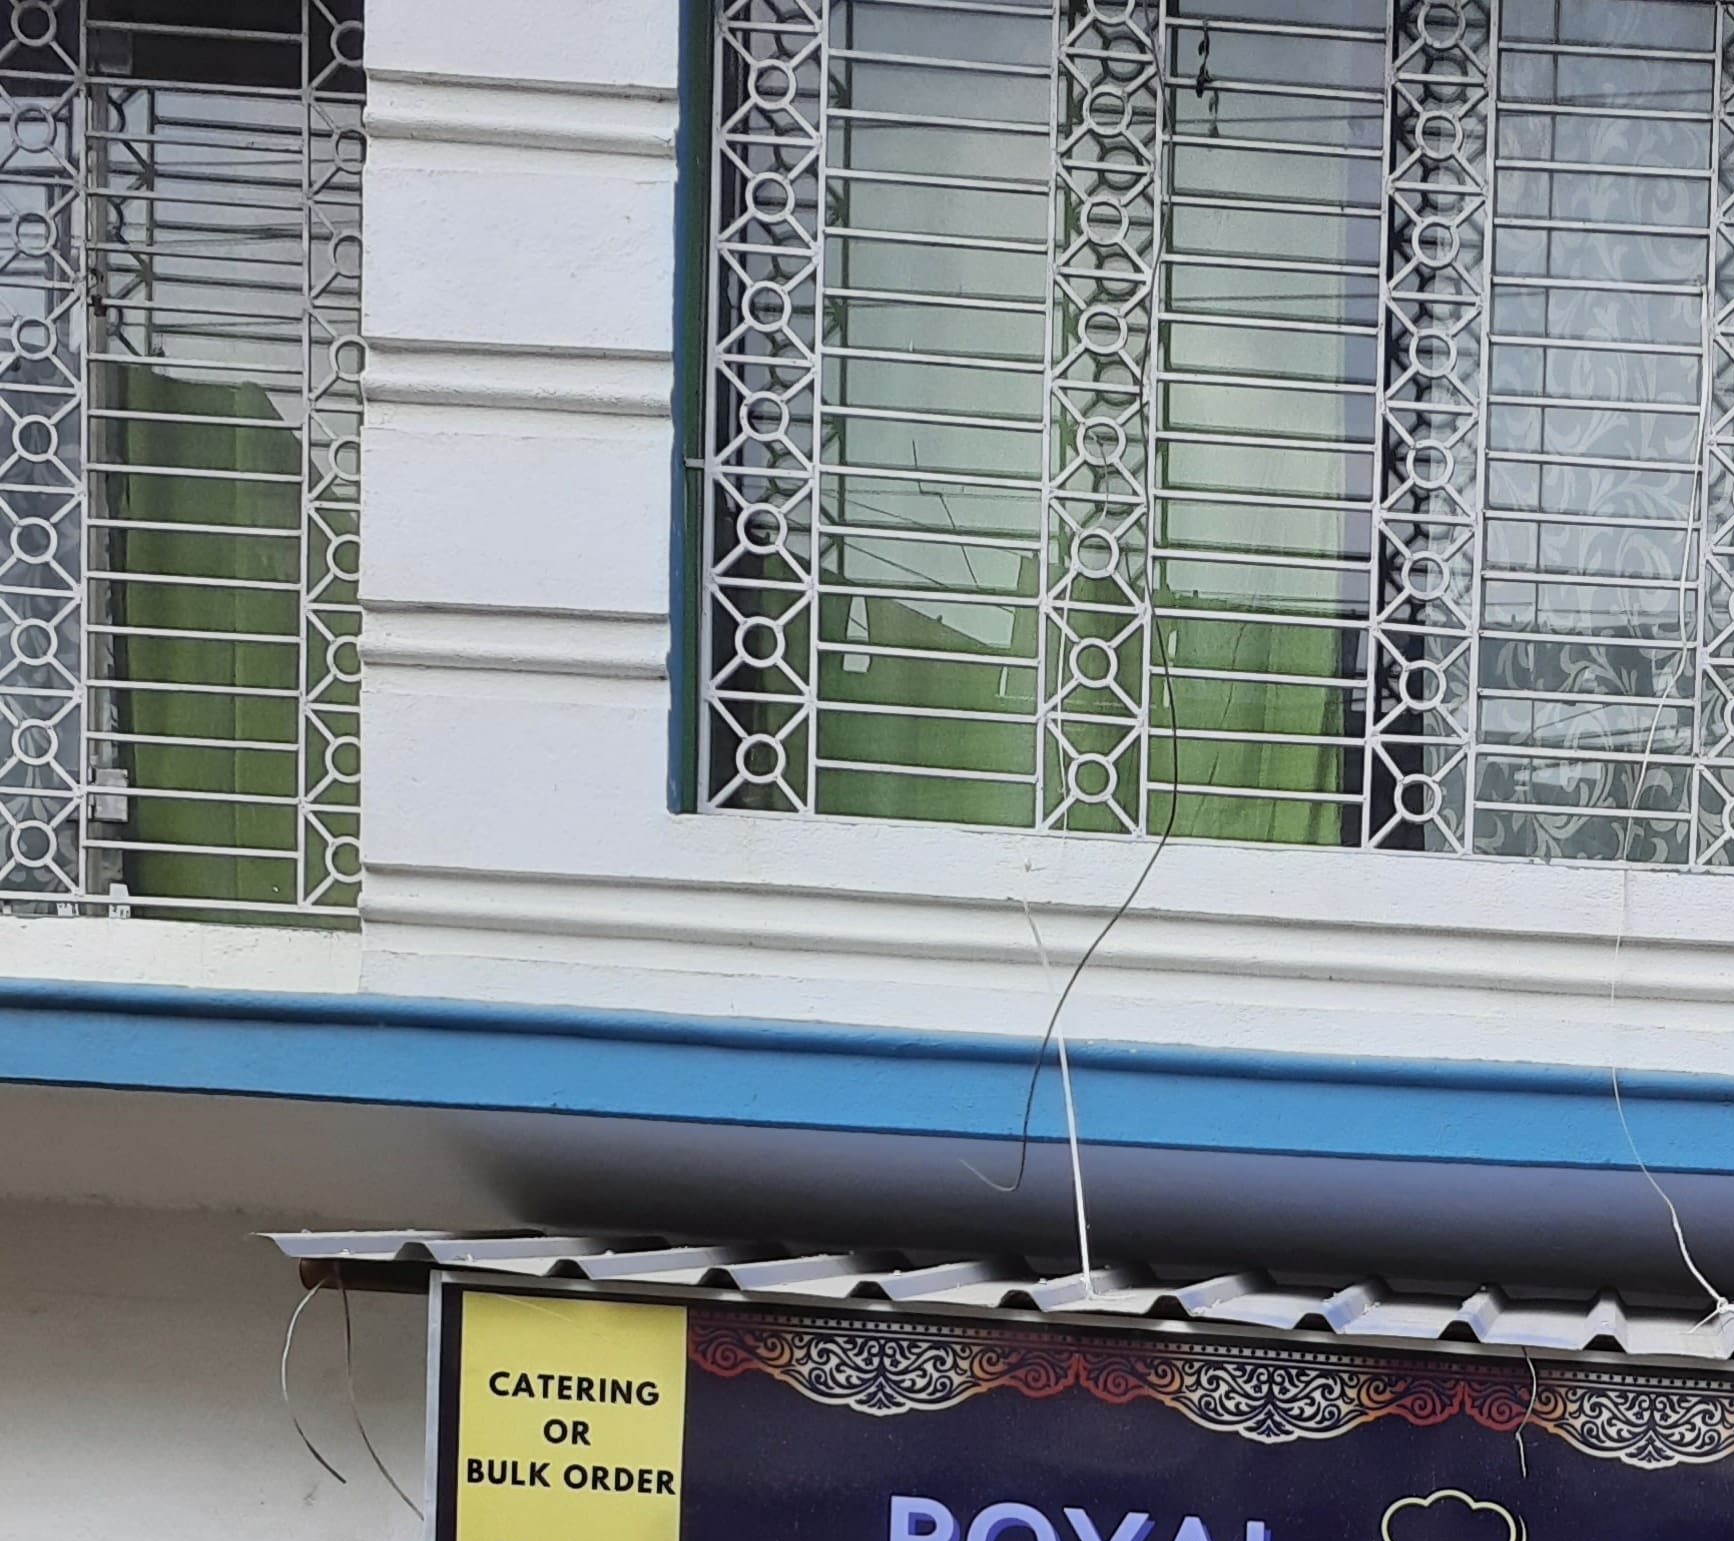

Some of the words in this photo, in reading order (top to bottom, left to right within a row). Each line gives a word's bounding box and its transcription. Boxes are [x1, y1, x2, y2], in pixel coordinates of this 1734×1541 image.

[489, 1371, 660, 1406] CATERING
[543, 1418, 591, 1446] OR
[467, 1458, 551, 1488] BULK
[563, 1464, 676, 1495] ORDER
